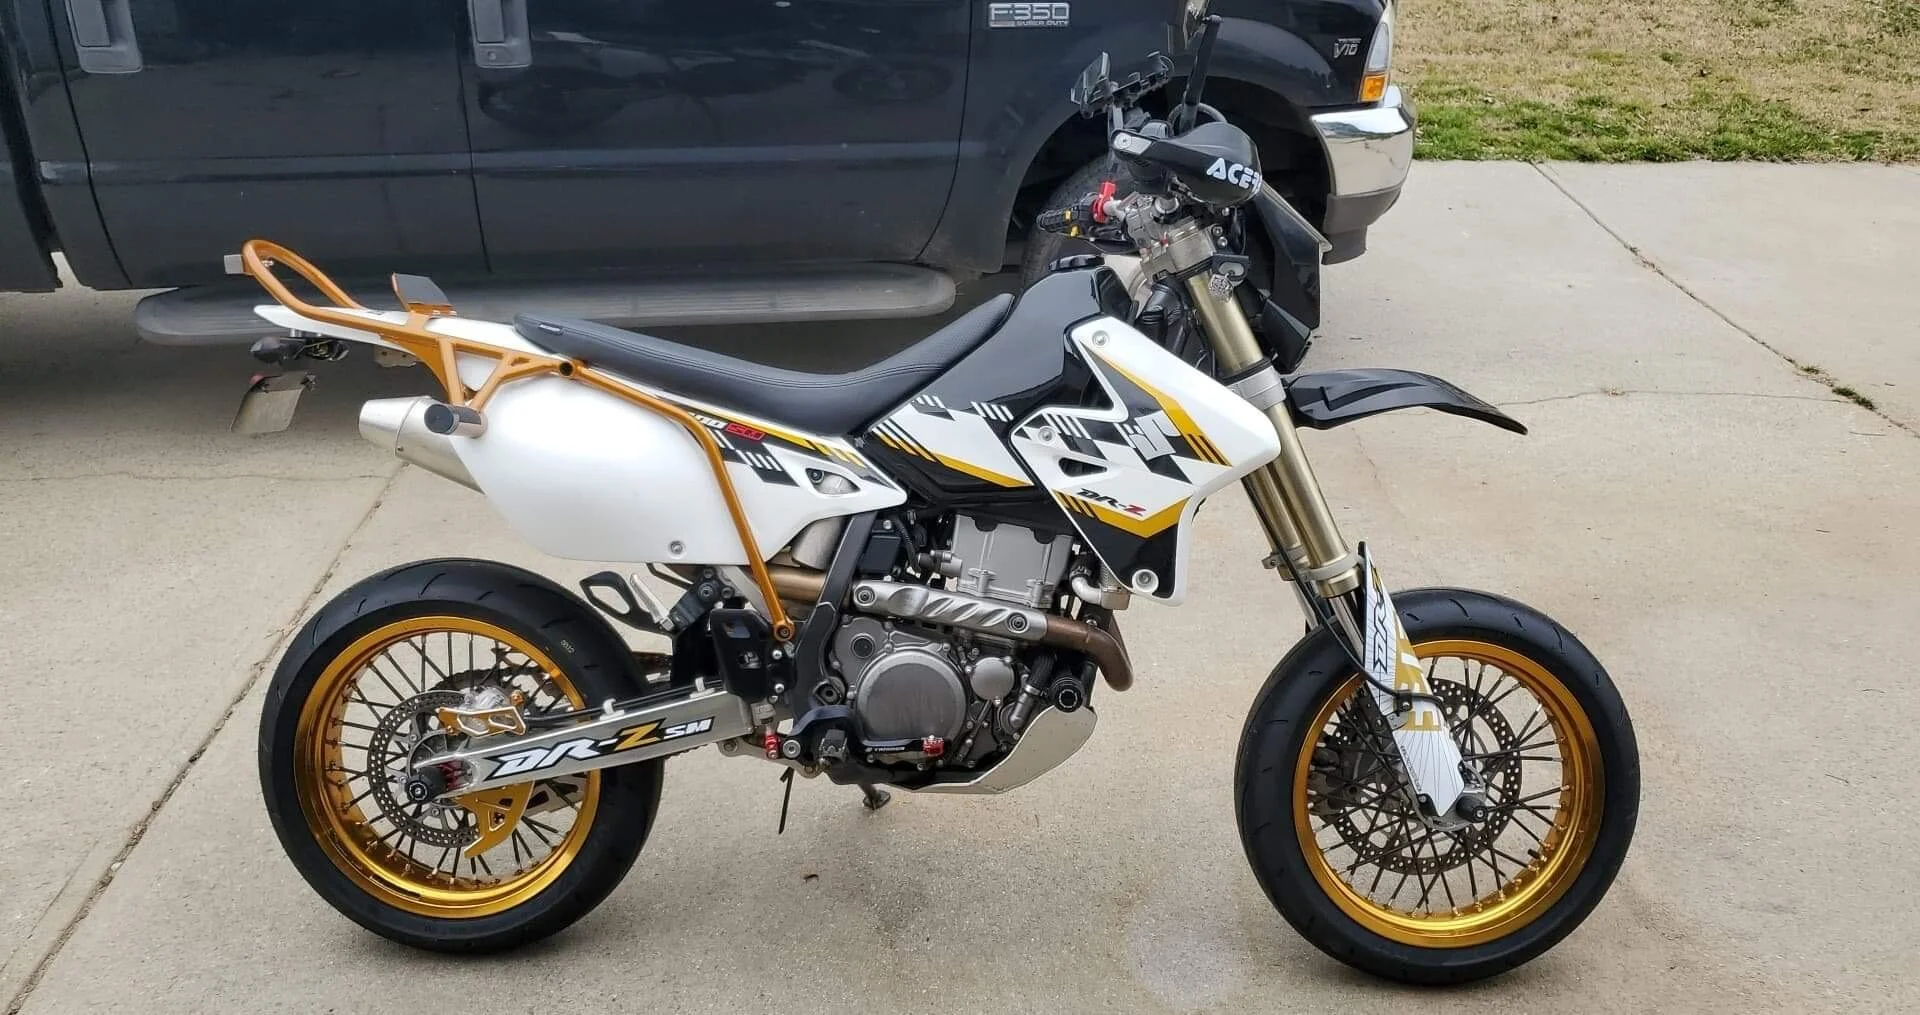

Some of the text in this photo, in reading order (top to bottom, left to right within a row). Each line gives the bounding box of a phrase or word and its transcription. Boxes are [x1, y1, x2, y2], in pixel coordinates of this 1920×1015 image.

[1076, 487, 1147, 517] DR-Z
[486, 717, 715, 781] DR-Z SM
